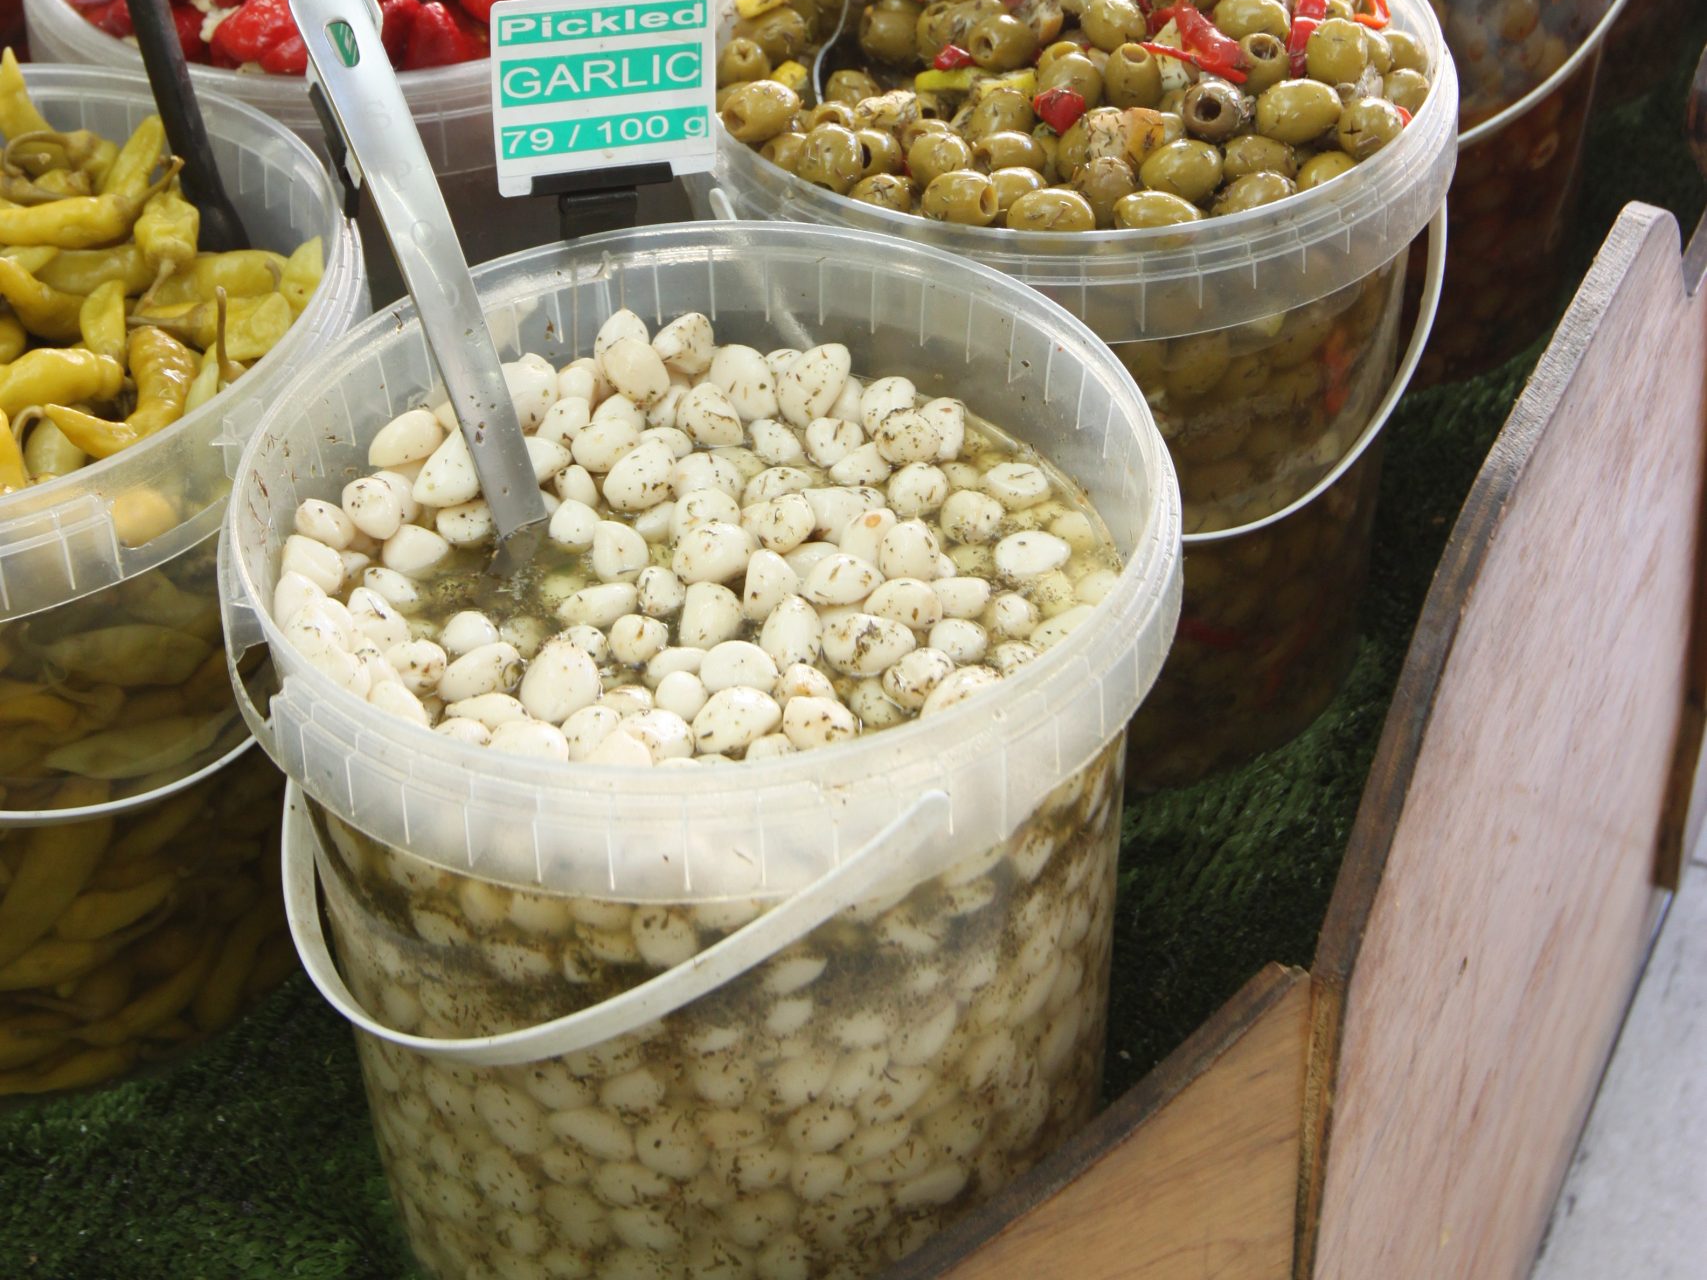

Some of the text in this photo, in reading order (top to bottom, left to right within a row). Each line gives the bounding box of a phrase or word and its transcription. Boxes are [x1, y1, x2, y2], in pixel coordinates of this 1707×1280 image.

[501, 2, 704, 41] Pickled
[503, 52, 700, 99] GARLIC
[503, 115, 707, 154] 79 / 100 g
